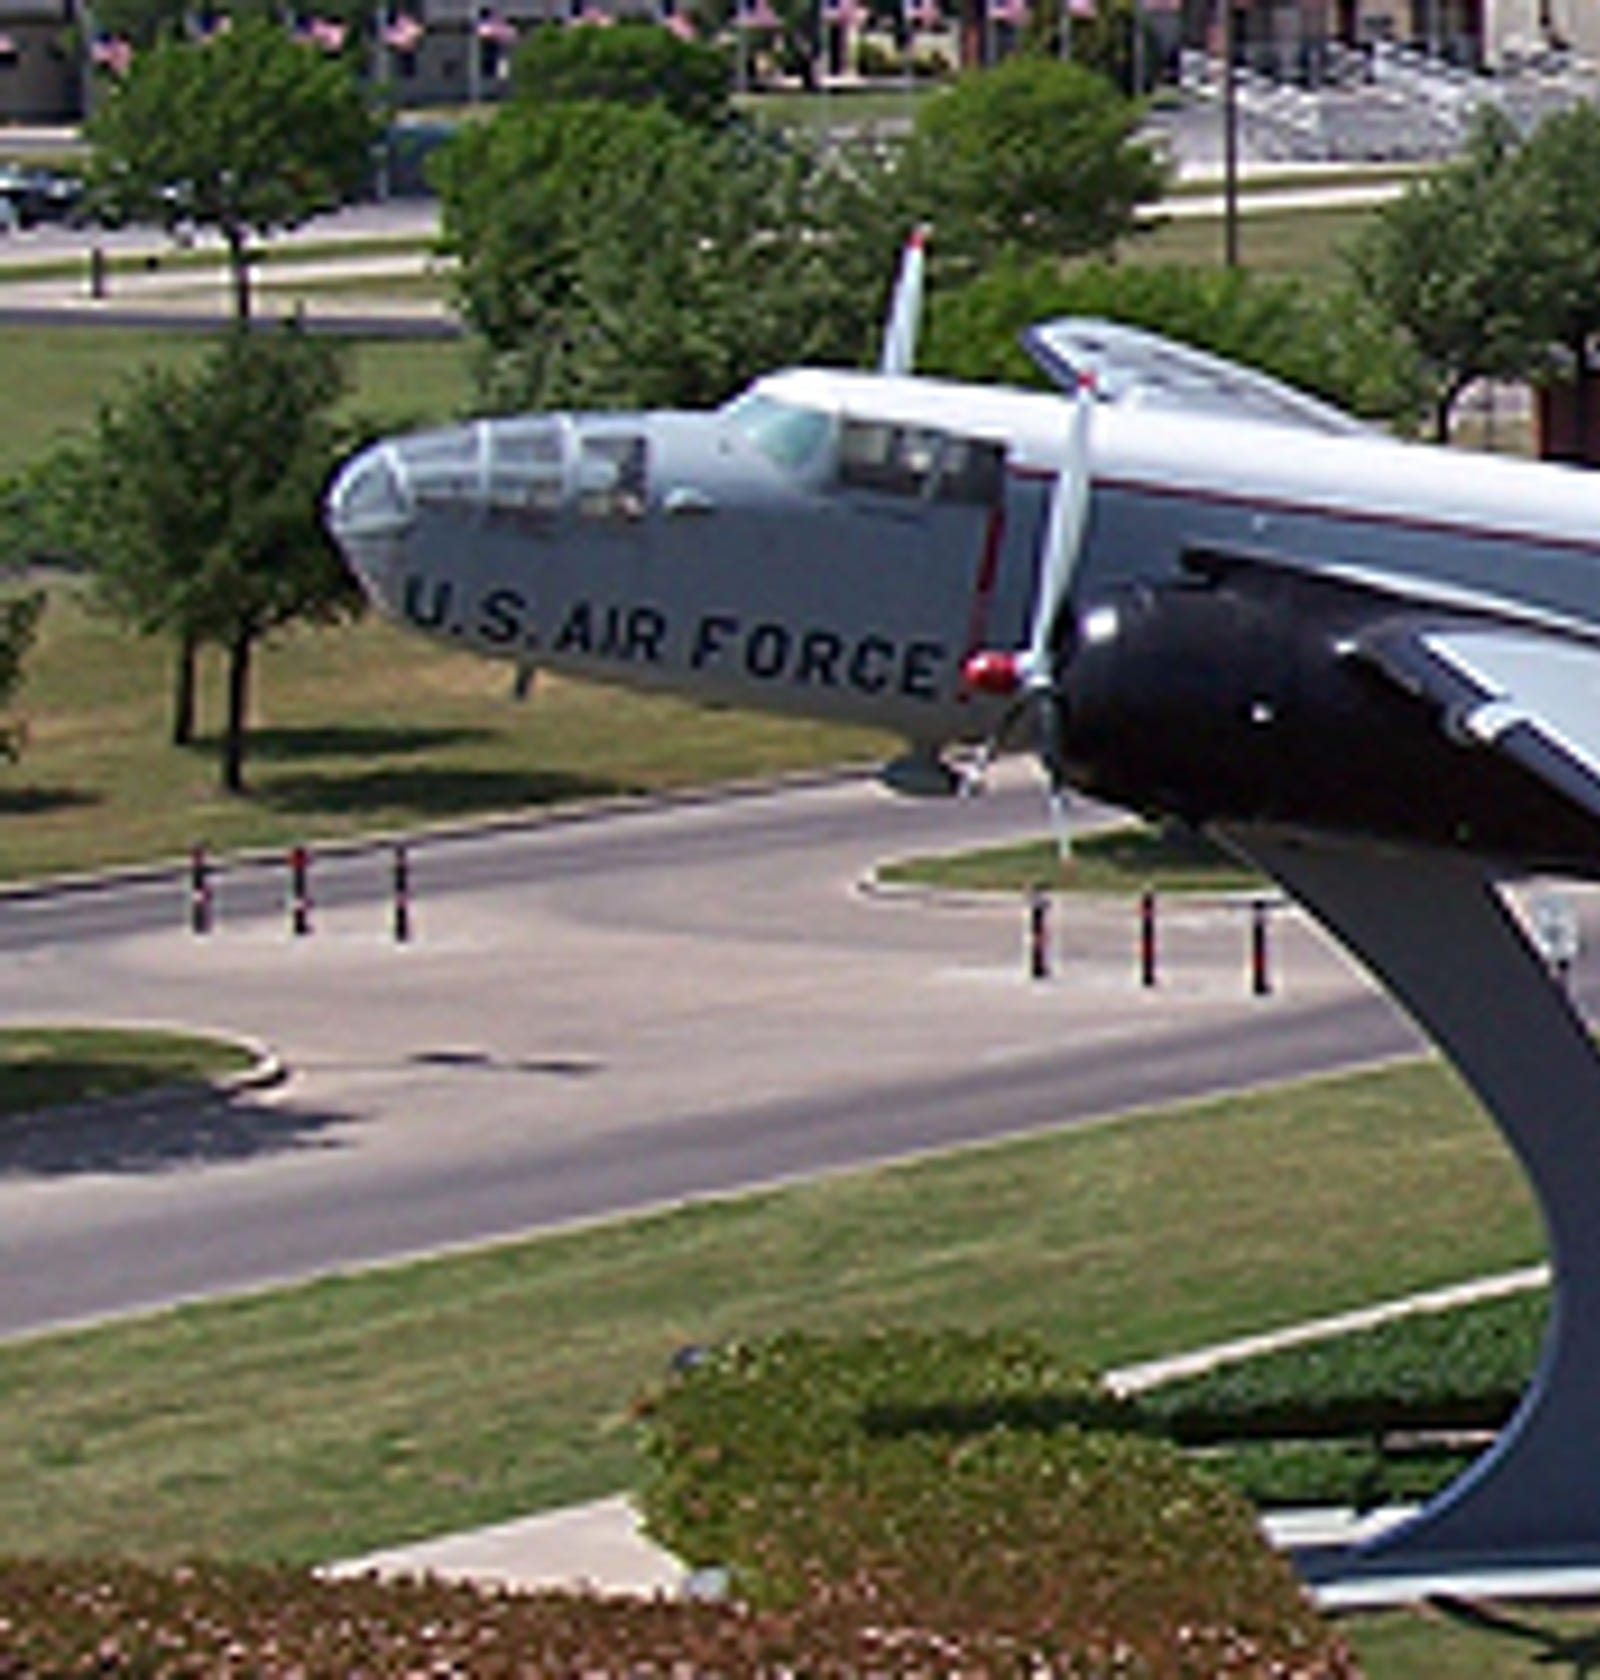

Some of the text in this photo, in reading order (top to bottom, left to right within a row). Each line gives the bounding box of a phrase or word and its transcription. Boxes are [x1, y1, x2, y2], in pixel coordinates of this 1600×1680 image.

[405, 575, 944, 696] U.S. AIR FORCE
